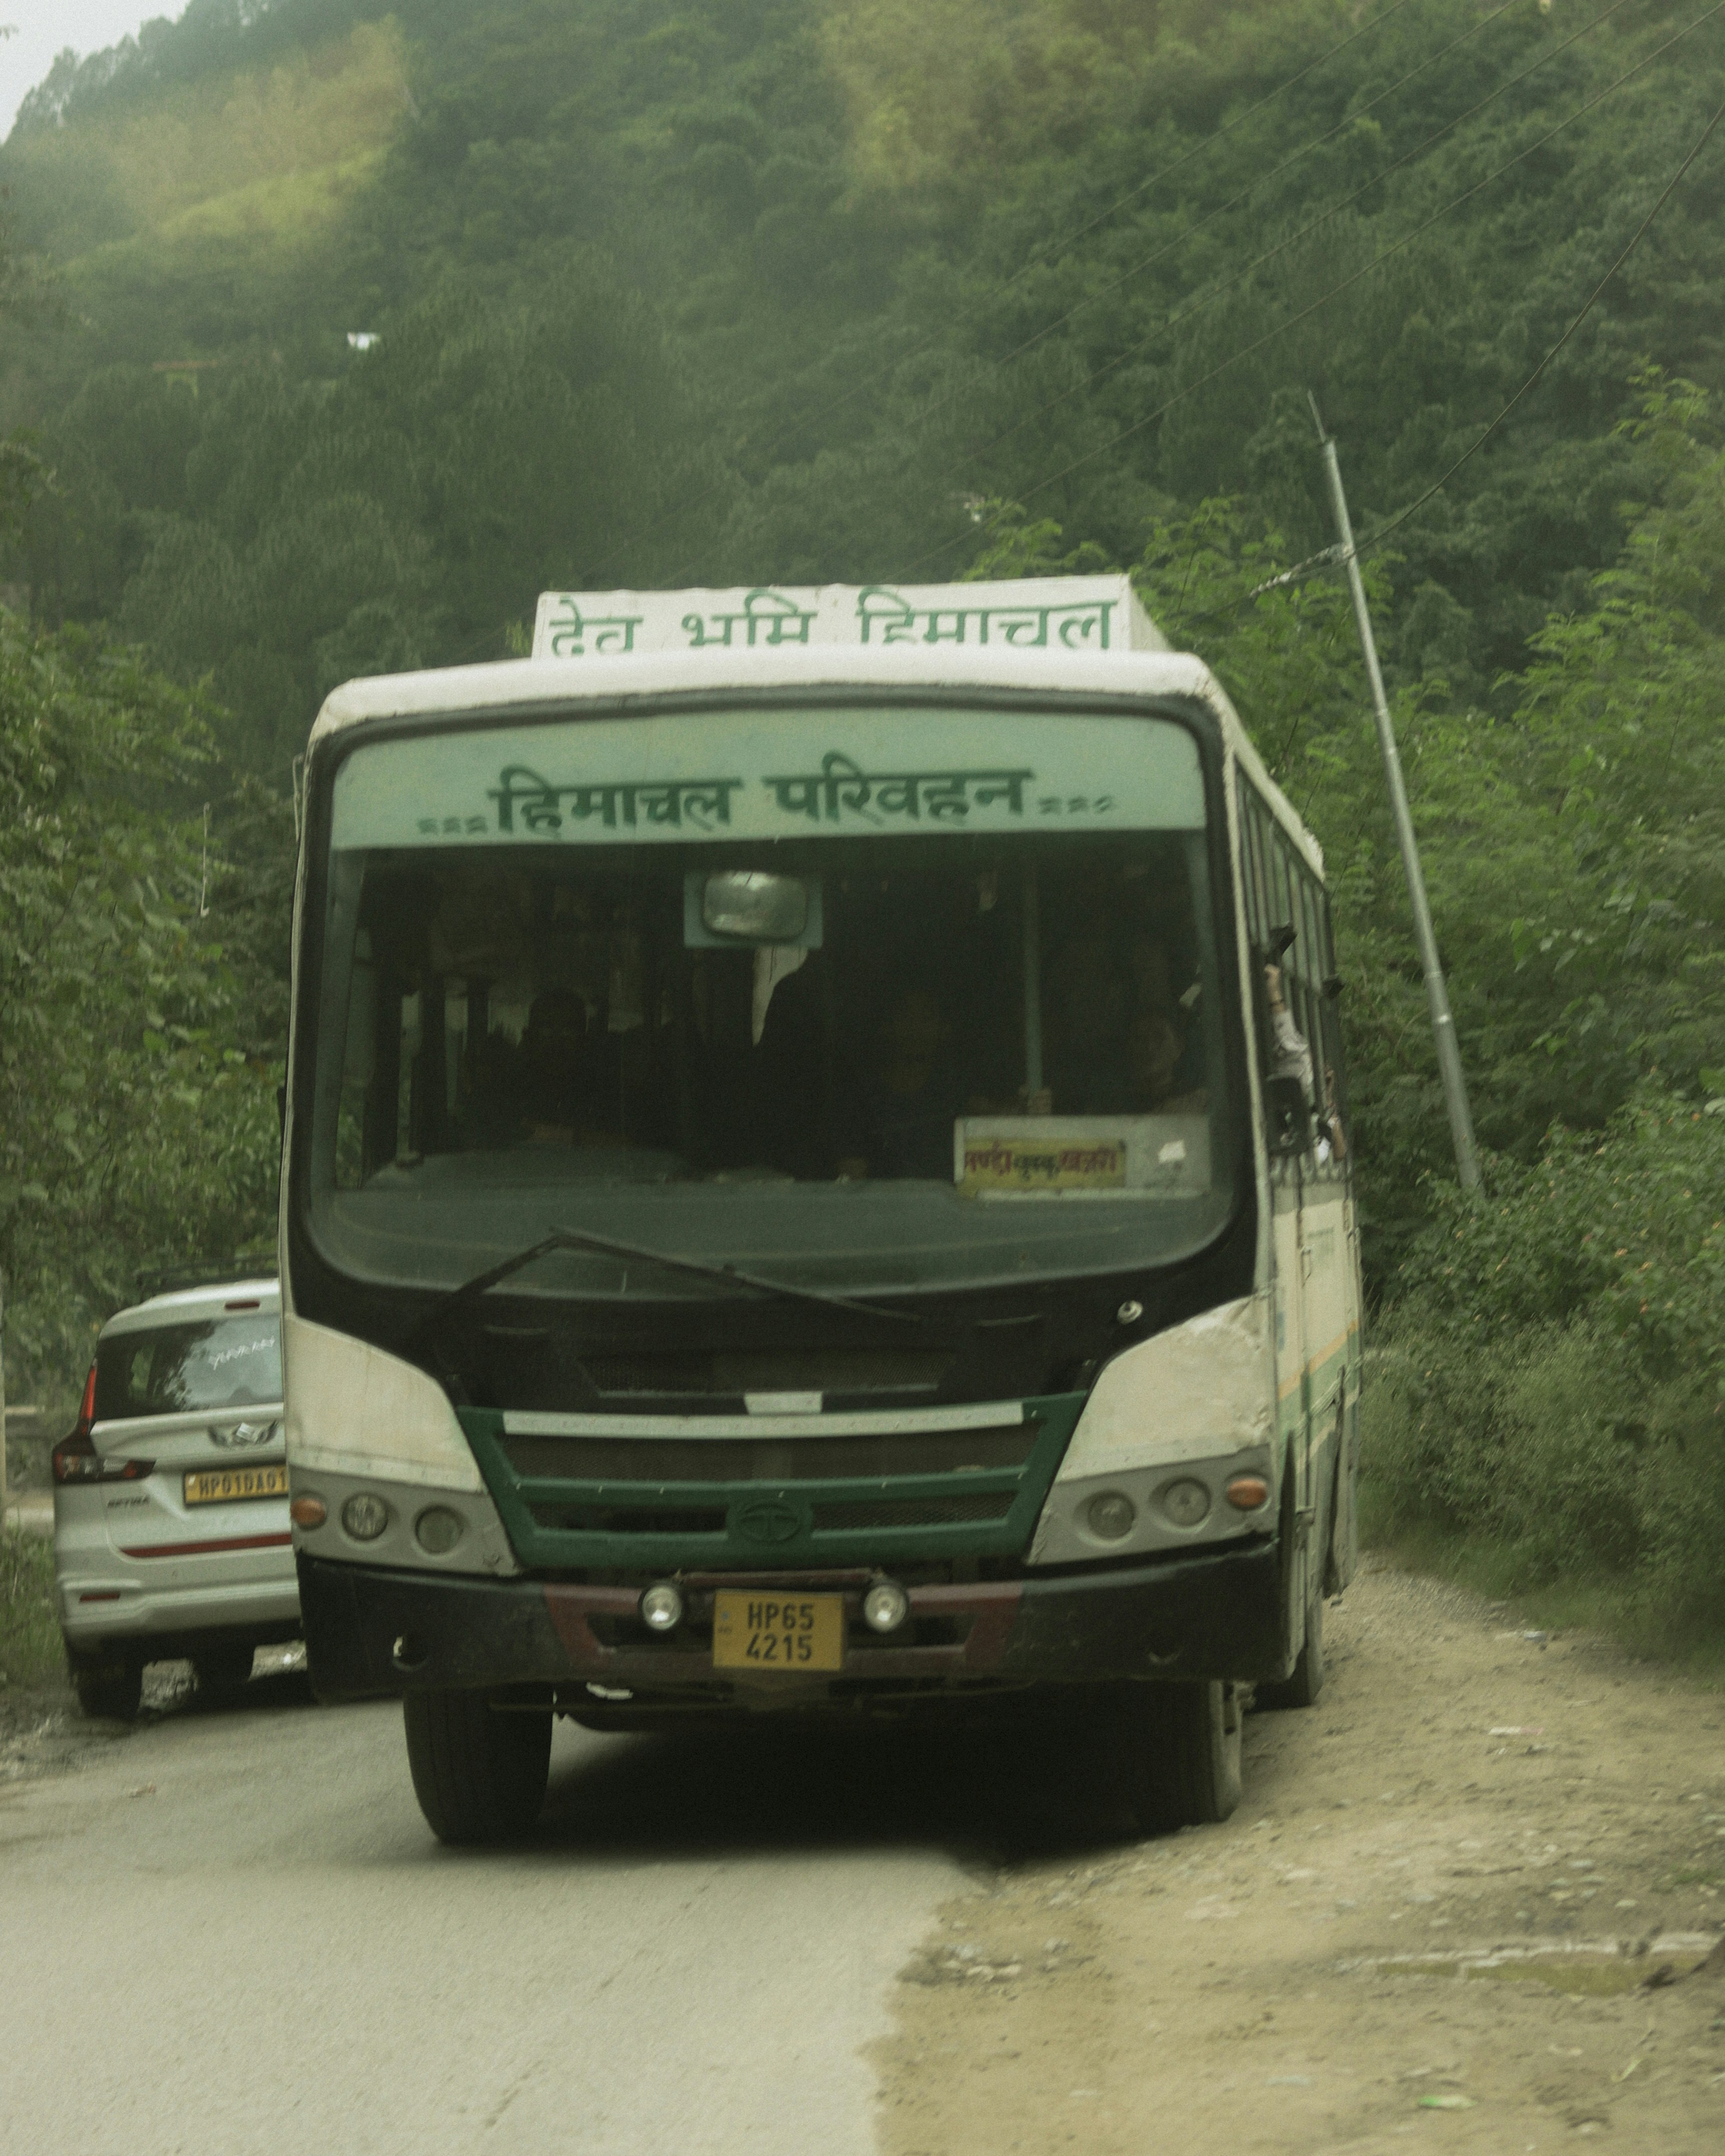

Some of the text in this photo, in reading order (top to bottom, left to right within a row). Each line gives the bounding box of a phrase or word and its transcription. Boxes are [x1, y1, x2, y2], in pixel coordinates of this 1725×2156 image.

[681, 587, 818, 647] भमि
[486, 749, 1037, 841] हिमाचल परिवहन
[747, 1601, 815, 1630] HP65
[746, 1633, 813, 1662] 4215
